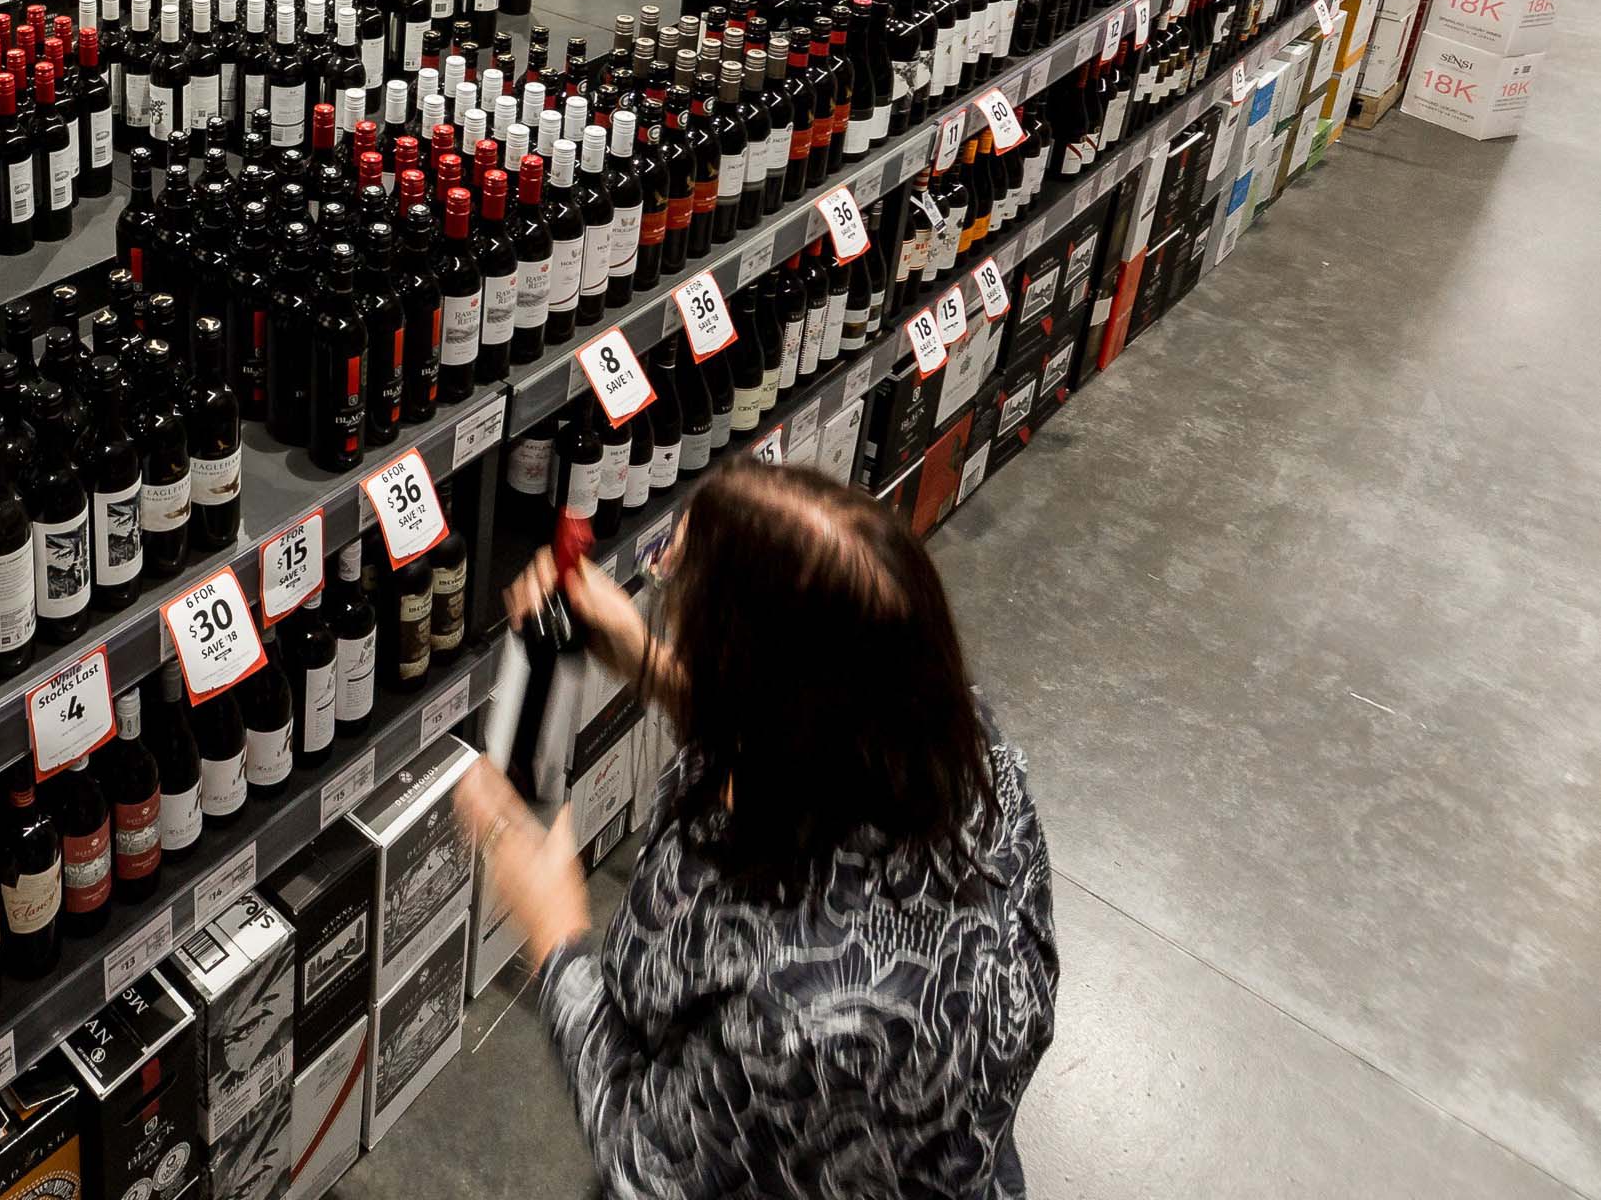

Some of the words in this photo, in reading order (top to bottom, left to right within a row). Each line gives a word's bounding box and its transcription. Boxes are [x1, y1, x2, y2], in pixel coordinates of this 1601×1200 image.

[1440, 52, 1474, 70] SENSI
[1423, 70, 1480, 103] 18K
[1502, 81, 1531, 97] 18K
[686, 287, 691, 295] 6
[691, 280, 703, 291] FOR
[690, 290, 715, 319] $36
[698, 318, 711, 332] SAVE
[599, 346, 621, 374] $8
[606, 378, 627, 395] SAVE
[335, 411, 365, 425] BLACK
[382, 473, 388, 483] 6
[388, 463, 406, 479] FOR
[387, 474, 422, 513] $36
[399, 512, 416, 528] SAVE
[279, 535, 285, 547] 2
[286, 525, 304, 544] FOR
[277, 537, 307, 570] $15
[279, 571, 298, 586] SAVE
[186, 597, 194, 609] 6
[194, 584, 216, 604] FOR
[189, 599, 233, 643] $30
[201, 640, 225, 659] SAVE
[225, 632, 238, 644] $18
[38, 681, 74, 709] Stocks
[74, 664, 99, 685] Last
[50, 664, 82, 690] While
[60, 695, 85, 723] $4
